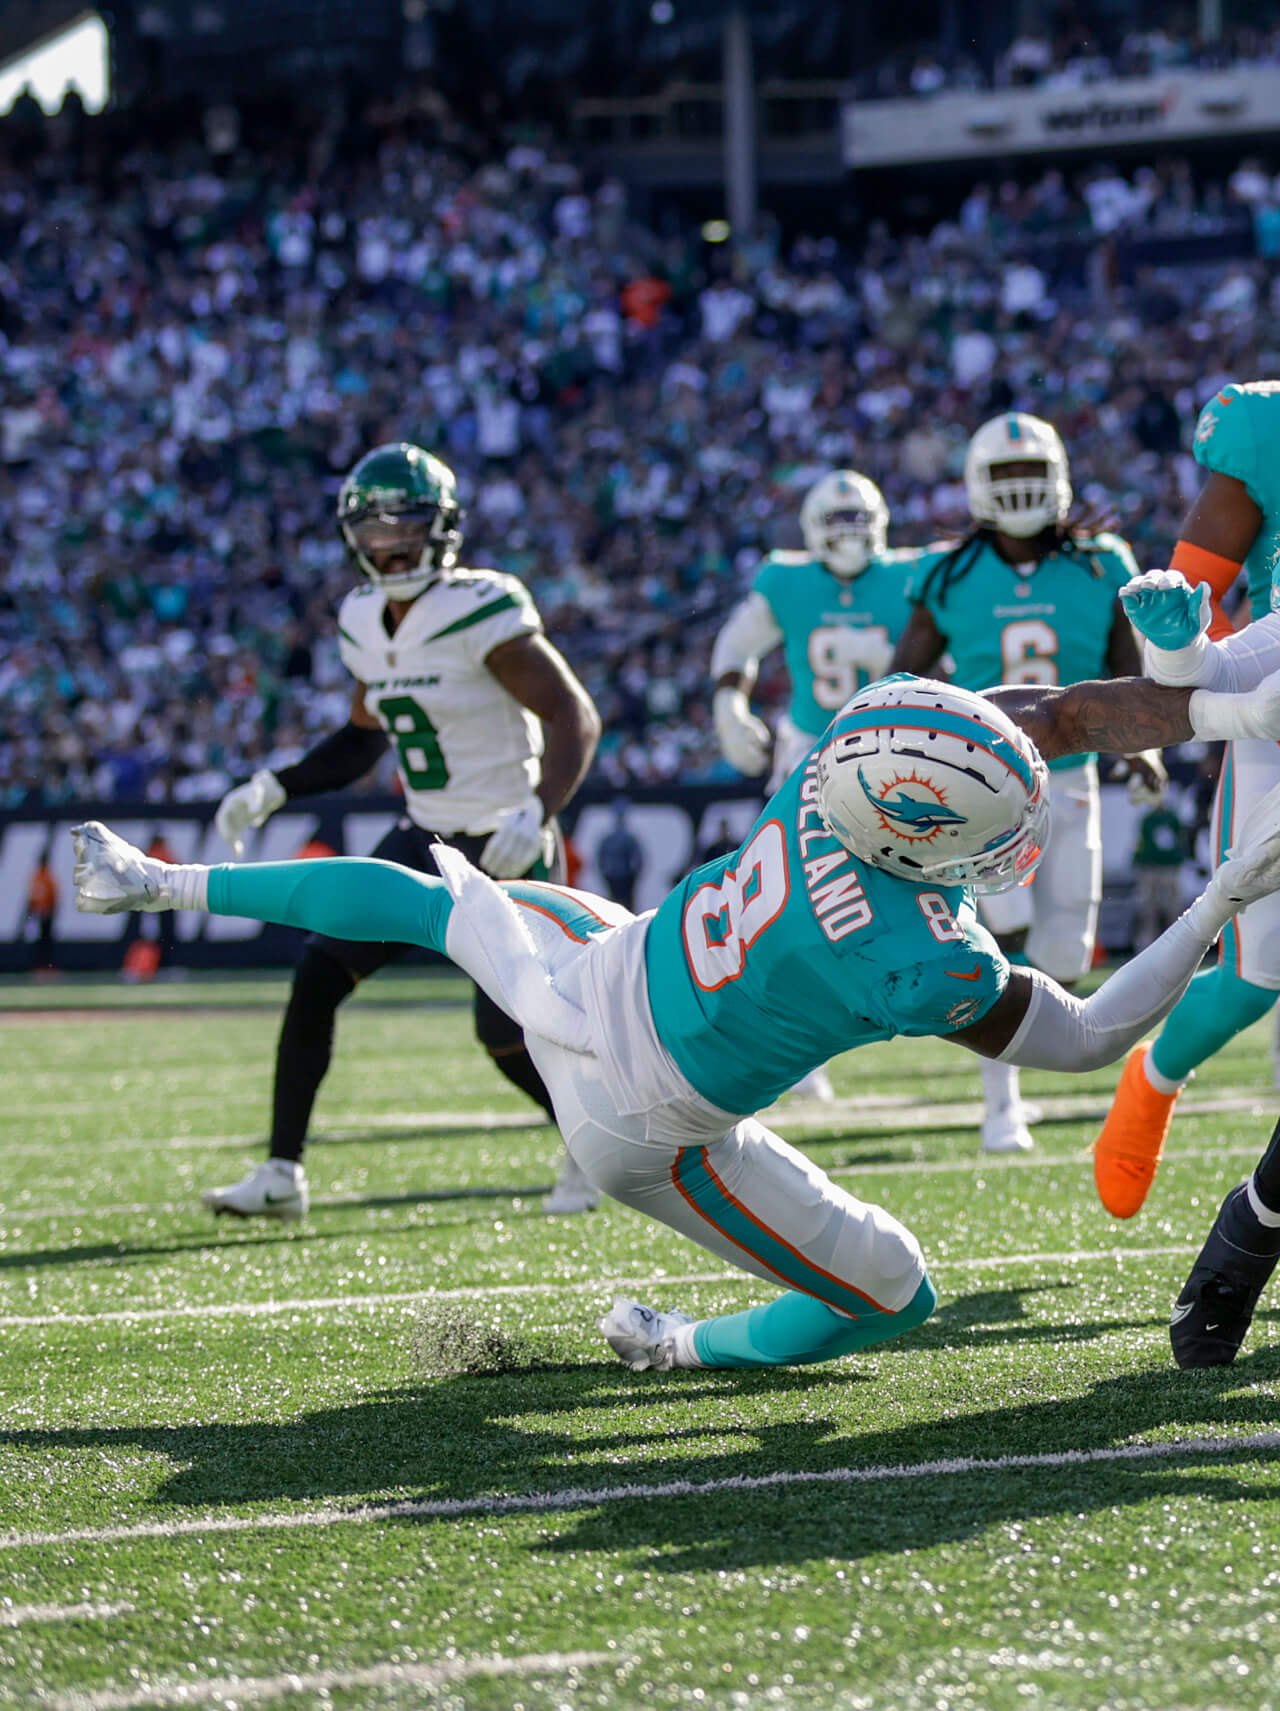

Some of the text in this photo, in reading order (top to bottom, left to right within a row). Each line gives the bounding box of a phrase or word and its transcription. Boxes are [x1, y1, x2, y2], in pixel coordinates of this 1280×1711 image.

[1001, 618, 1060, 687] 6
[378, 696, 451, 791] 8
[681, 818, 791, 992] 8
[917, 891, 966, 943] 8
